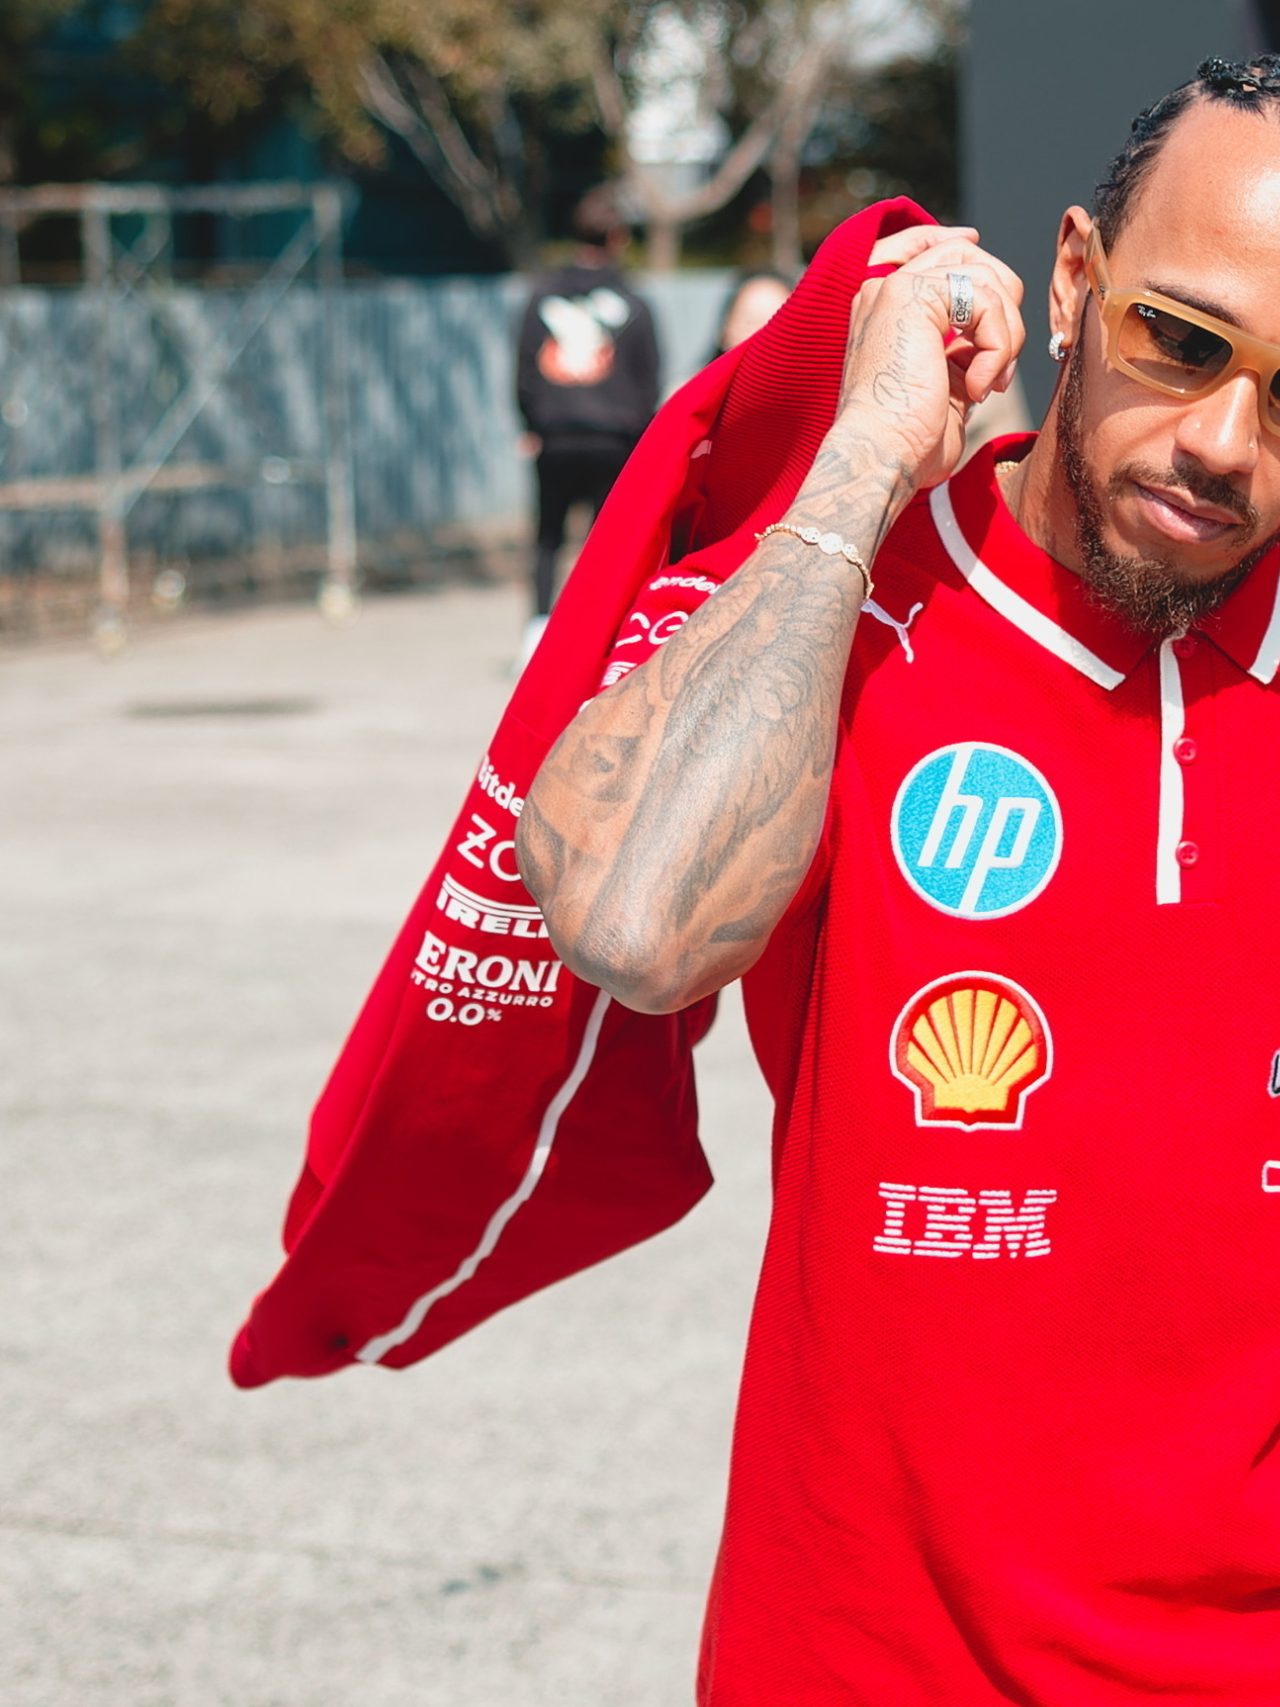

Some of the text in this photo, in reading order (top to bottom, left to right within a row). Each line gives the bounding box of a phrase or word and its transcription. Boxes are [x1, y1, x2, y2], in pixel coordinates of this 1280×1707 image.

[917, 745, 1042, 913] hp
[410, 967, 554, 1008] TRO AZZURRO
[414, 929, 563, 993] ERONI
[426, 997, 502, 1026] 0.0%
[873, 1181, 1058, 1260] IBM
